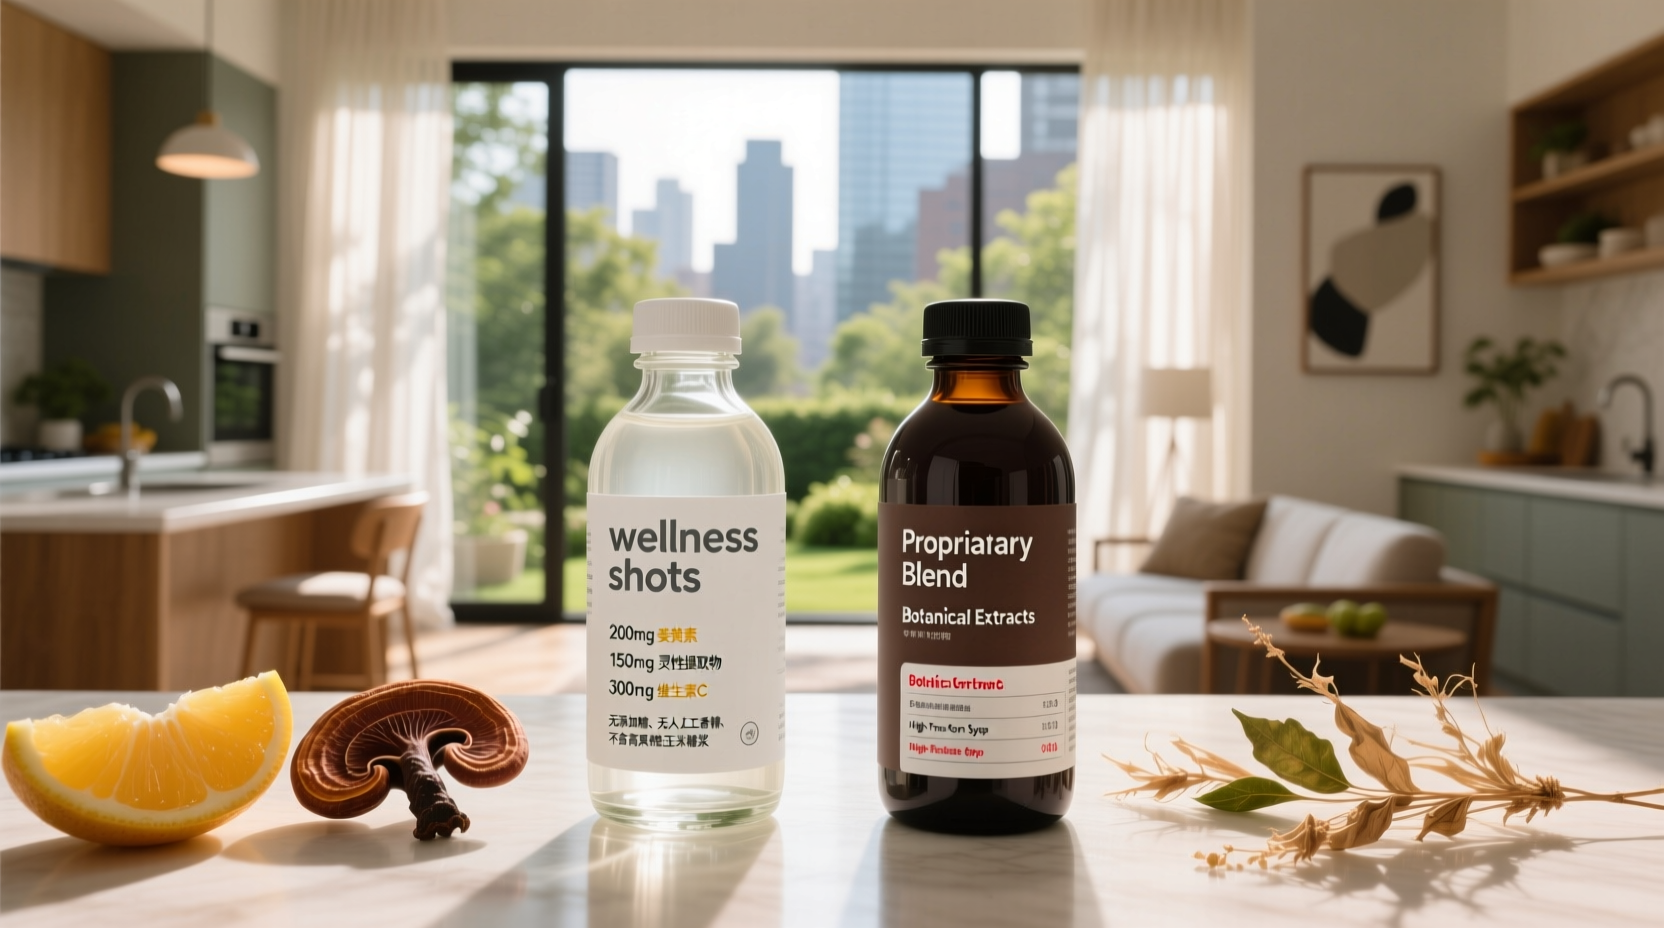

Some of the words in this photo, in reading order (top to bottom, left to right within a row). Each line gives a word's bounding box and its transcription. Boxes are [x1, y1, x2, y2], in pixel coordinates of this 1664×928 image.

[609, 519, 758, 553] wellness
[902, 528, 1033, 562] Propriatary
[609, 558, 701, 593] shots
[902, 561, 967, 588] Blend
[902, 606, 971, 625] Botanical
[975, 609, 1036, 626] Extracts
[609, 624, 655, 646] 200mg
[609, 652, 655, 674] 150mg
